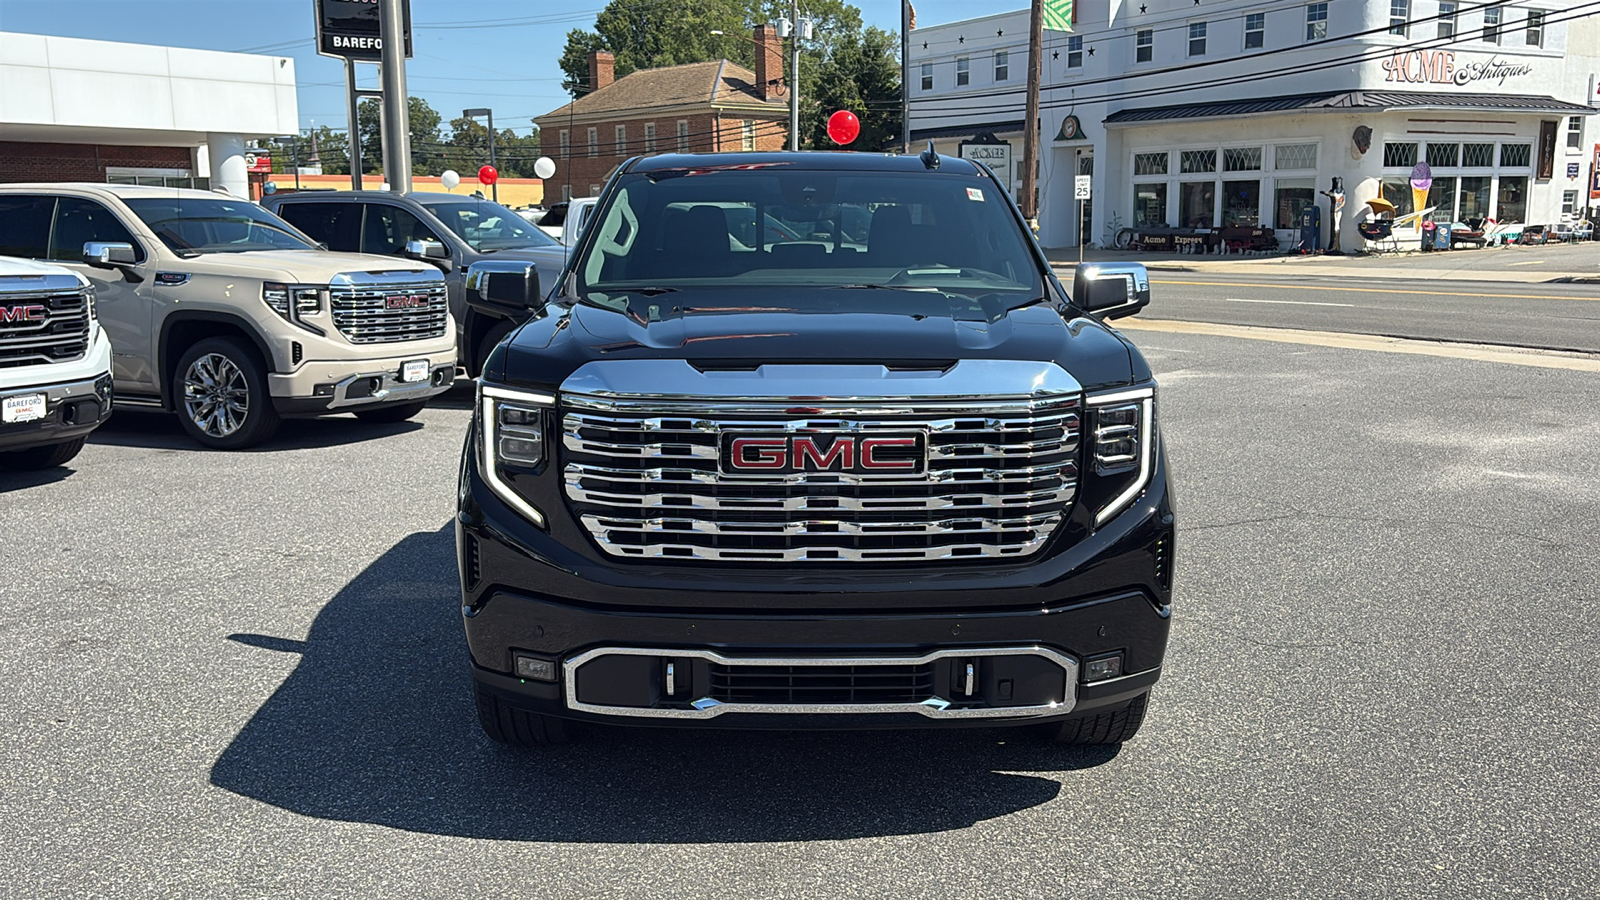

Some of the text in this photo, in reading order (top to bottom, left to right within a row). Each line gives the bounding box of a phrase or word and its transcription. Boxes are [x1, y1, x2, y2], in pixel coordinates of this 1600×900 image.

[333, 36, 382, 49] BAREFO
[1382, 49, 1532, 86] ACME Antiques
[970, 147, 1005, 159] ACME
[1076, 187, 1089, 197] 25
[1174, 236, 1203, 244] Express
[387, 294, 427, 308] GMC
[0, 305, 45, 323] MC
[7, 398, 42, 408] BAREFORD
[731, 436, 916, 470] GMC
